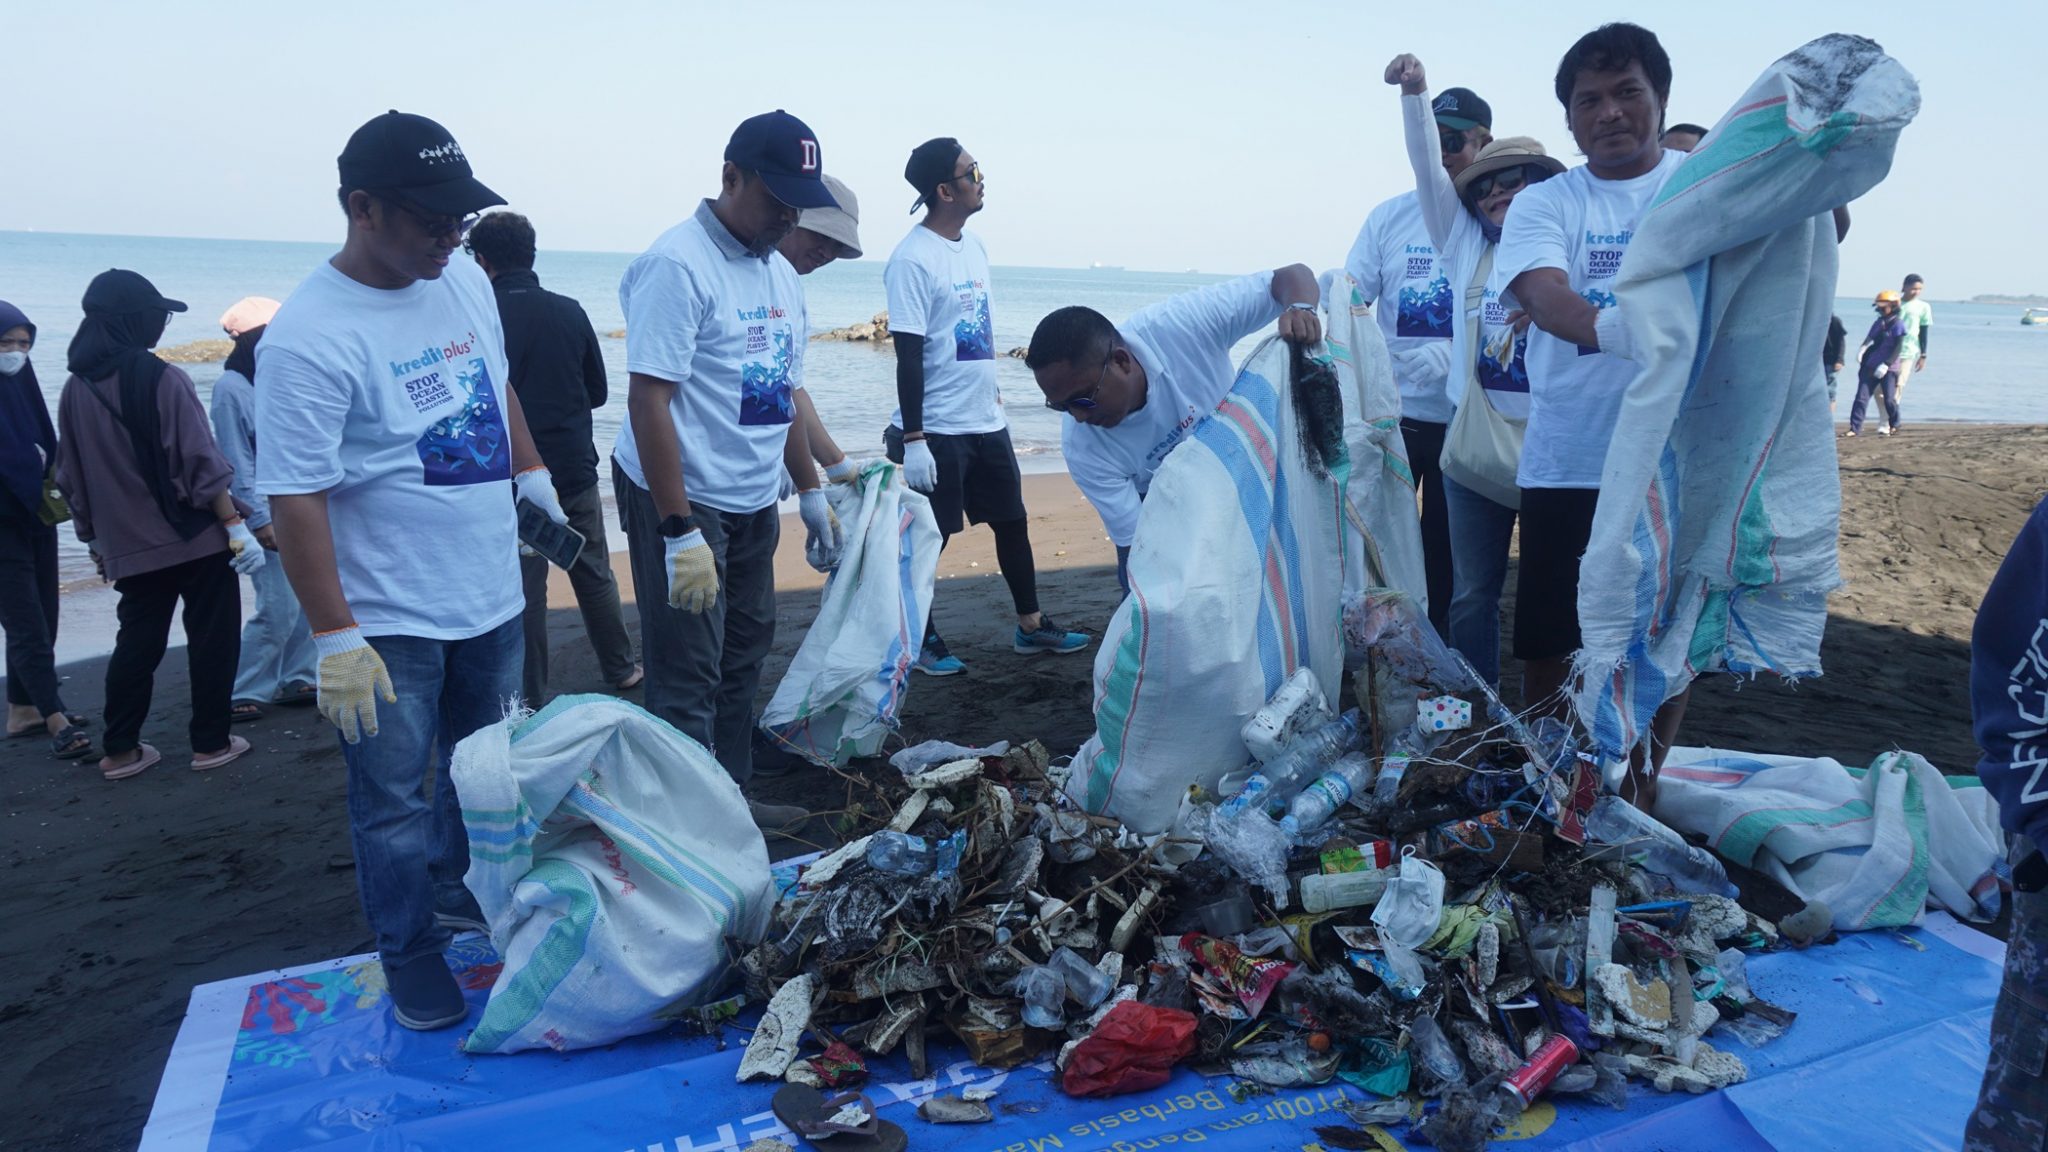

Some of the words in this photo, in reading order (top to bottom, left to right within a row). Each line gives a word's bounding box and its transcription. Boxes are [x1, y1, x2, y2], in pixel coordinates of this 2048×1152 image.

[801, 139, 817, 171] D
[1407, 257, 1433, 265] STOP
[1590, 250, 1623, 260] STOP
[747, 326, 766, 336] STOP
[404, 372, 440, 394] STOP
[410, 382, 446, 401] OCEAN
[413, 388, 450, 408] PLASTIC
[417, 395, 455, 414] POLLUTION
[1068, 1089, 1227, 1138] Berbasis
[1208, 1086, 1347, 1132] Program
